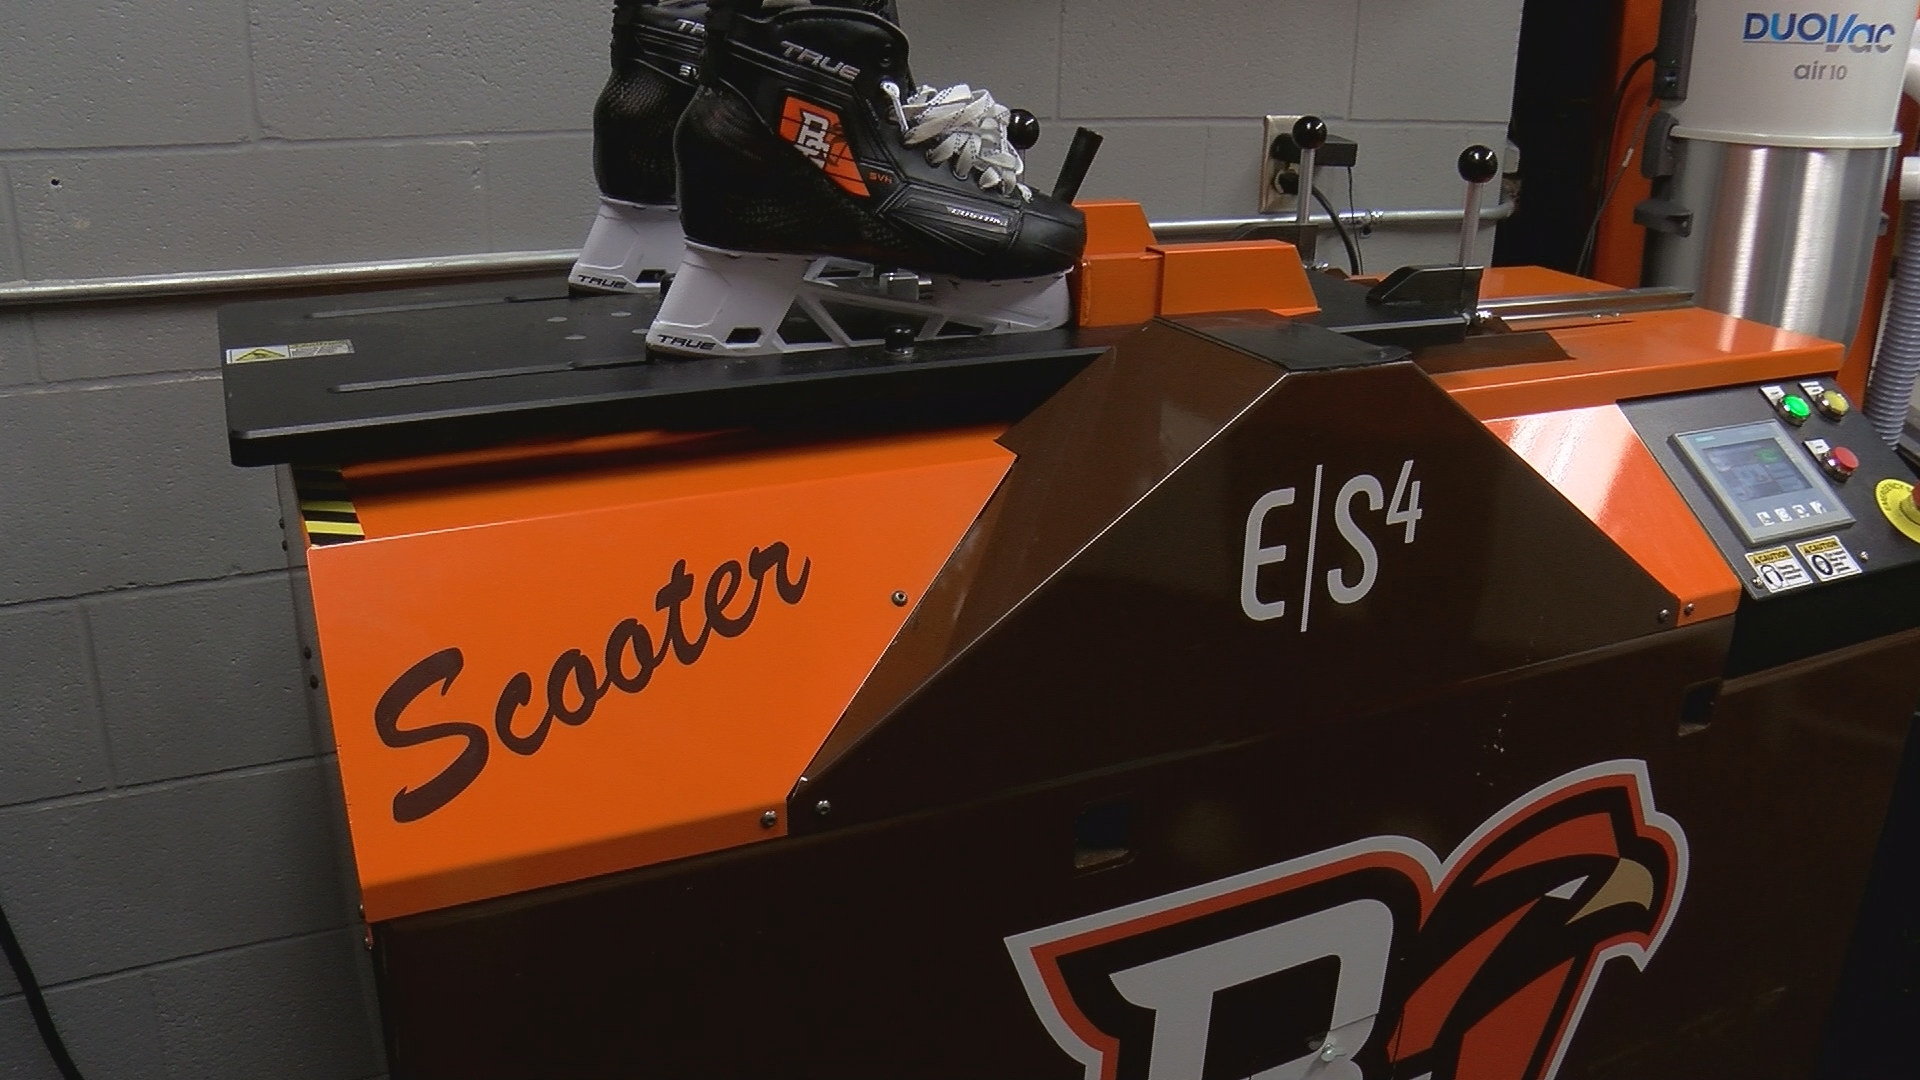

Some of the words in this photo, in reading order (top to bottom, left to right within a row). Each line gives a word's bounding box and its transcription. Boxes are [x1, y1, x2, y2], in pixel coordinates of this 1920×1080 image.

[676, 18, 706, 35] TR
[780, 40, 862, 81] TRUE
[1793, 60, 1828, 81] air
[1829, 64, 1848, 81] 10
[578, 274, 627, 289] TRUE
[657, 334, 717, 351] TRUE
[1808, 540, 1839, 552] CAUTION
[1757, 549, 1790, 562] CAUTION
[374, 540, 812, 824] Scooter
